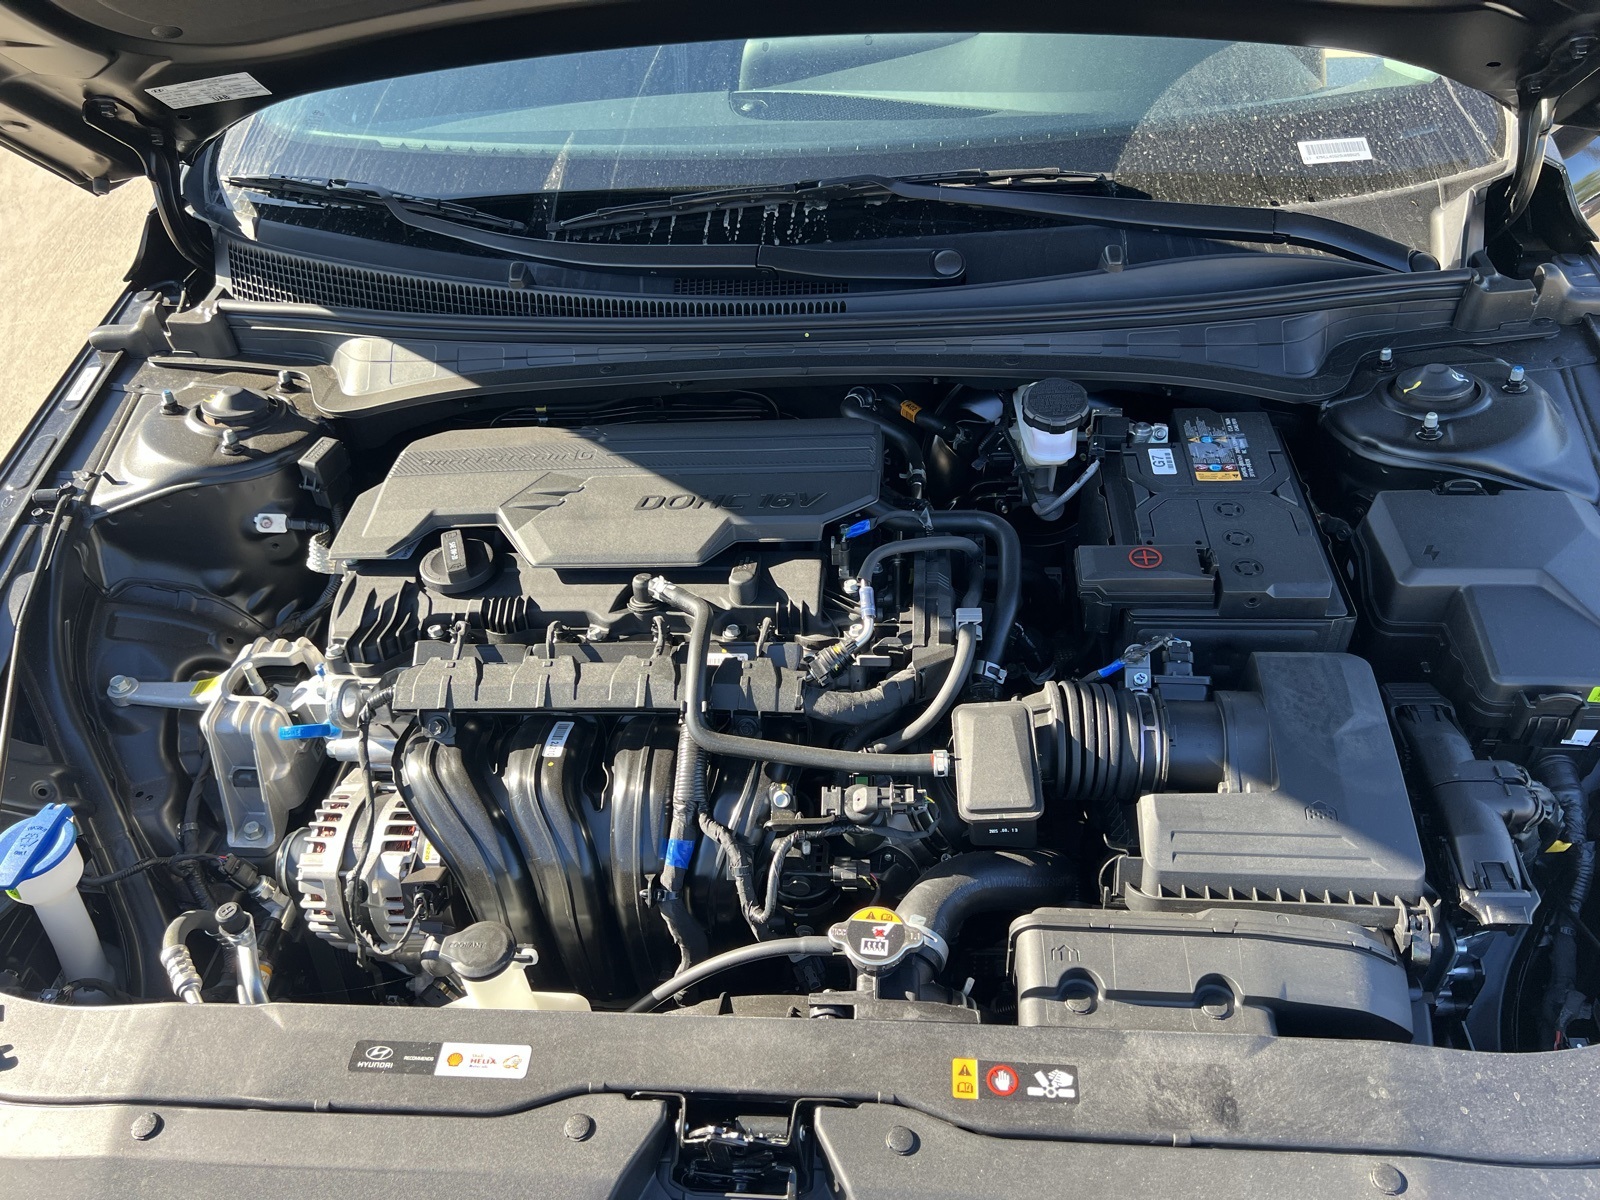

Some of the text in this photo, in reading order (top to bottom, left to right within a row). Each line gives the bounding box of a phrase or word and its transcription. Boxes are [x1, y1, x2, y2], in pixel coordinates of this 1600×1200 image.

[1152, 455, 1165, 467] G7
[634, 490, 828, 511] DOHC 16V
[357, 1061, 394, 1069] HYUNDAI
[470, 1057, 497, 1065] HELIX
